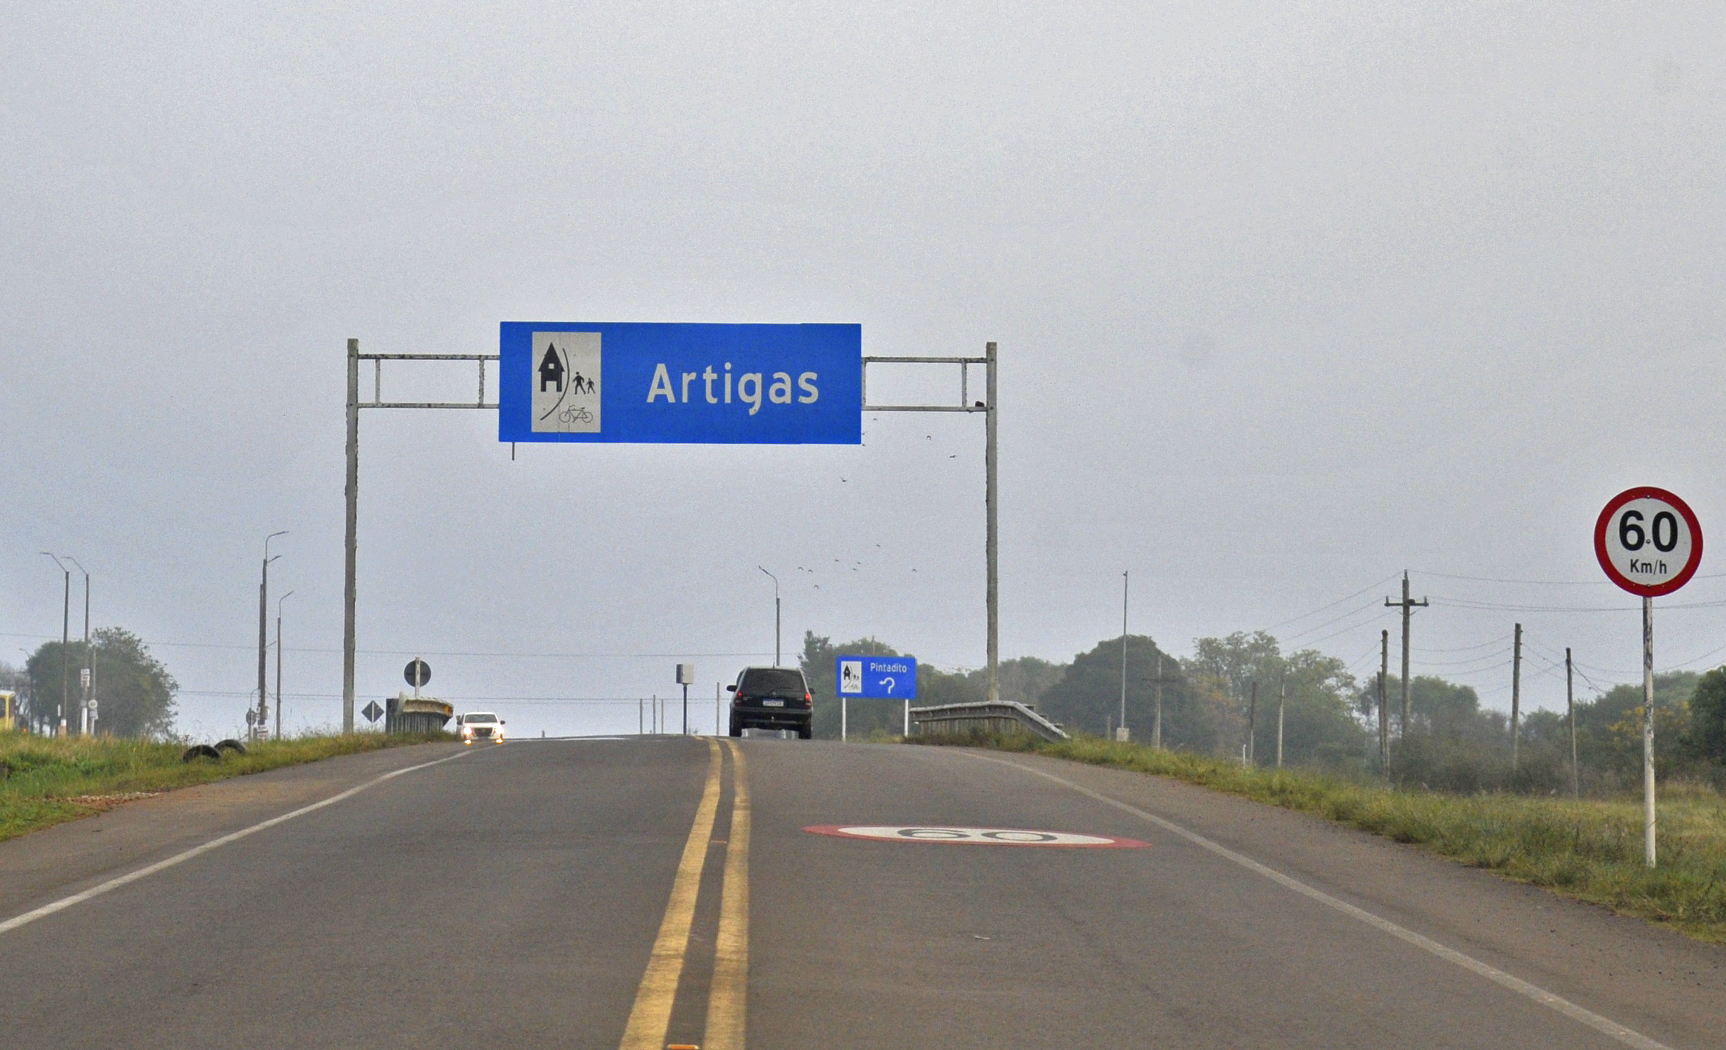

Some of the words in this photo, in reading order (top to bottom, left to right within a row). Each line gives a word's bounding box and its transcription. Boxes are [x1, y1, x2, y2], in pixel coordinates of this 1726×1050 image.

[646, 362, 819, 416] Artigas
[1619, 510, 1678, 552] 60
[1630, 559, 1667, 575] Km/h
[870, 662, 907, 673] Pintadito
[897, 828, 1058, 842] 60
